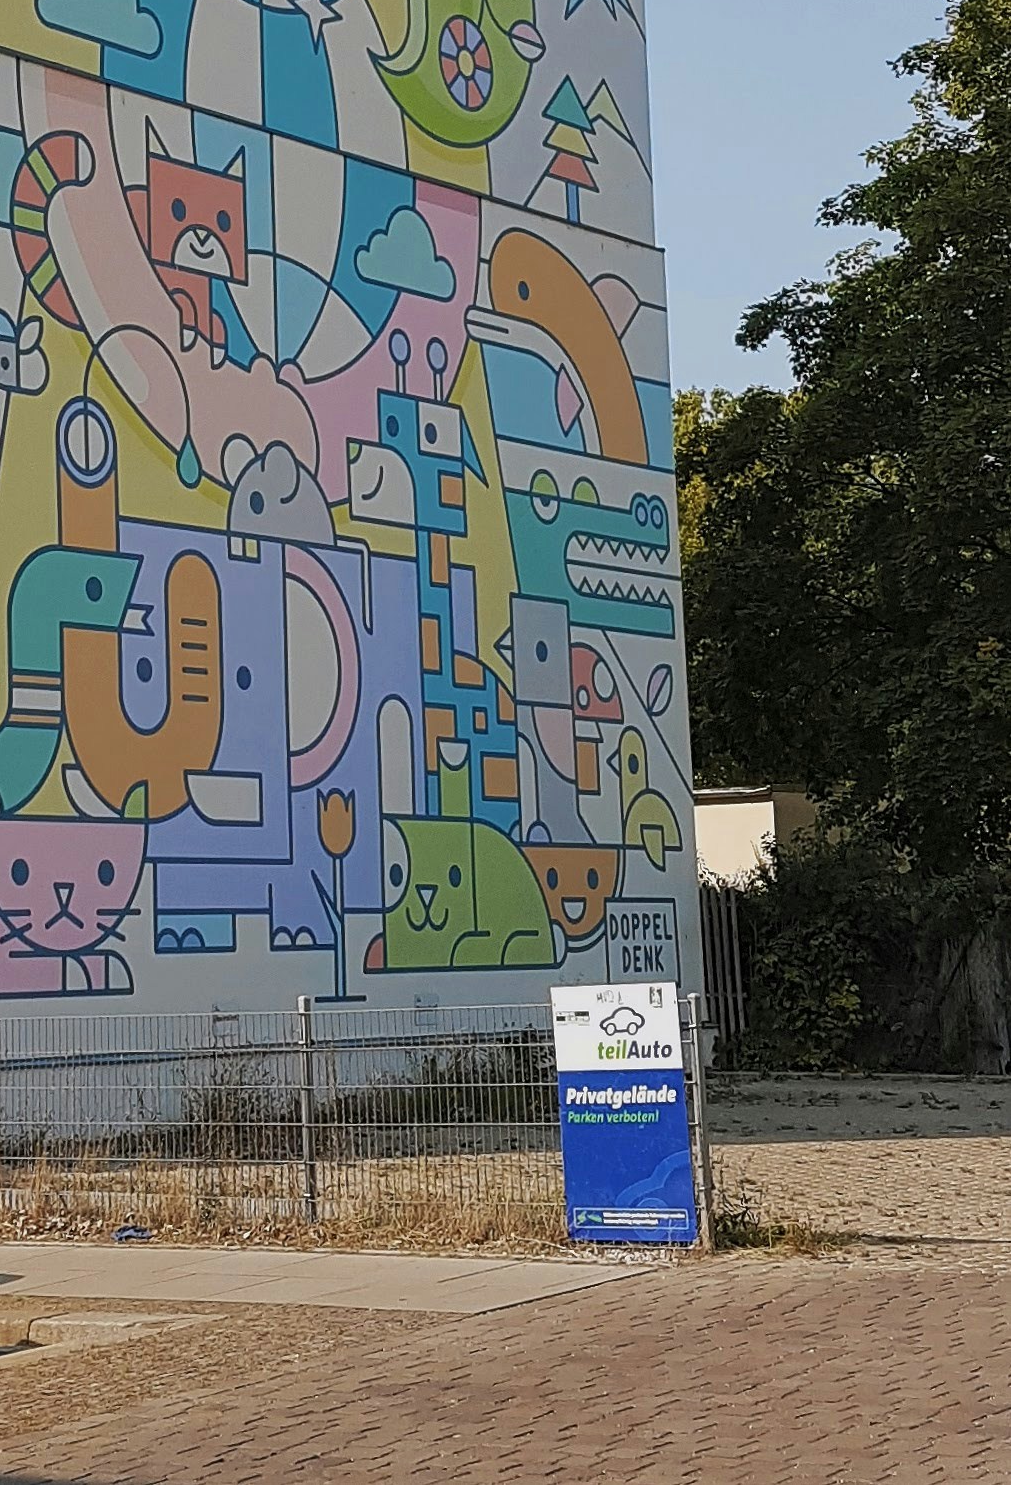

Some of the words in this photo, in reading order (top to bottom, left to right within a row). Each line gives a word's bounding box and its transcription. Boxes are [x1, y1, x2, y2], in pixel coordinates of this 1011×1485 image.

[609, 913, 673, 941] DOPPEL
[622, 945, 665, 974] DENK
[597, 1039, 673, 1060] teilAuto
[566, 1084, 677, 1110] Privatgelände
[567, 1110, 604, 1124] Parken
[606, 1108, 660, 1124] verboten!
